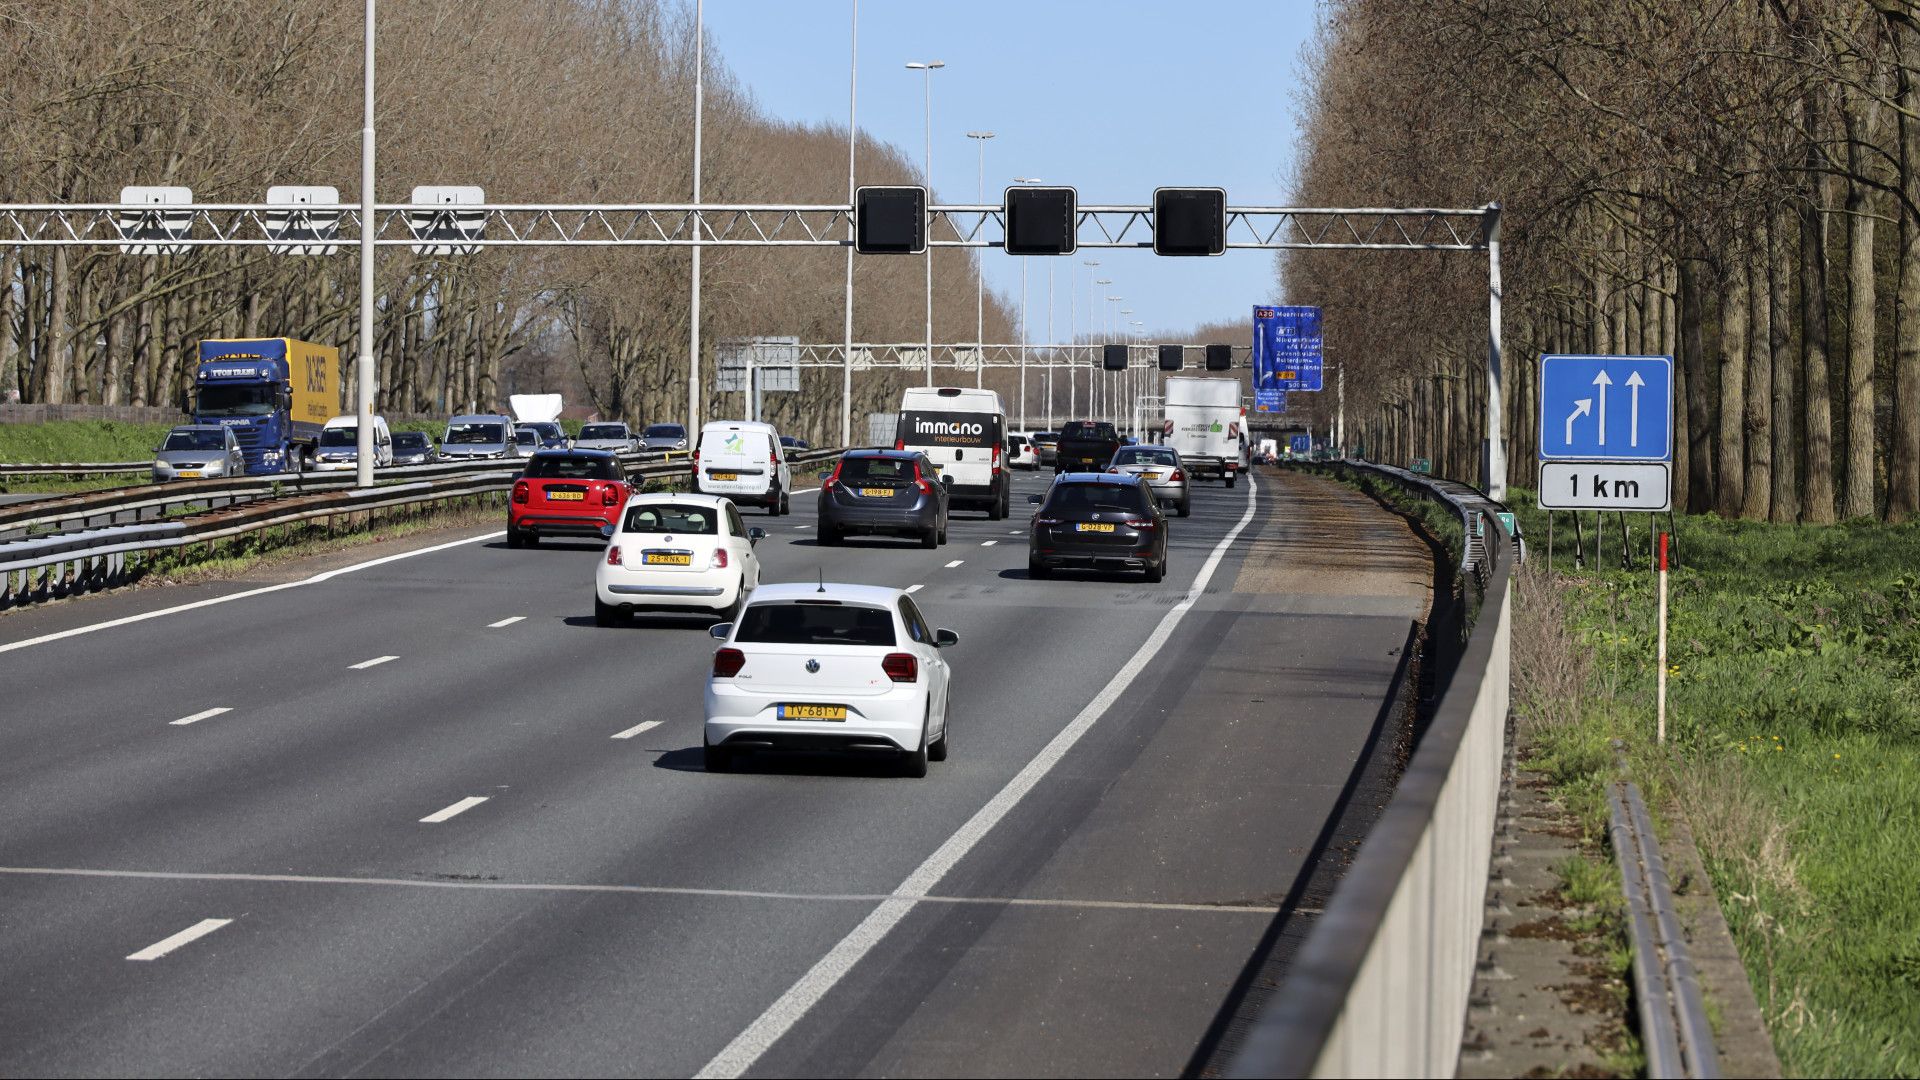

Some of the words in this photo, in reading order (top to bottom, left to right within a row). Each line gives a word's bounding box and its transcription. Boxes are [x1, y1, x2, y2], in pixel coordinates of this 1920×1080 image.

[915, 416, 983, 435] immano
[934, 434, 981, 443] interieurbouw
[1570, 474, 1577, 497] 1
[1593, 474, 1638, 498] km
[650, 555, 688, 563] 25-RNK-1
[789, 705, 840, 717] TV-681-V
